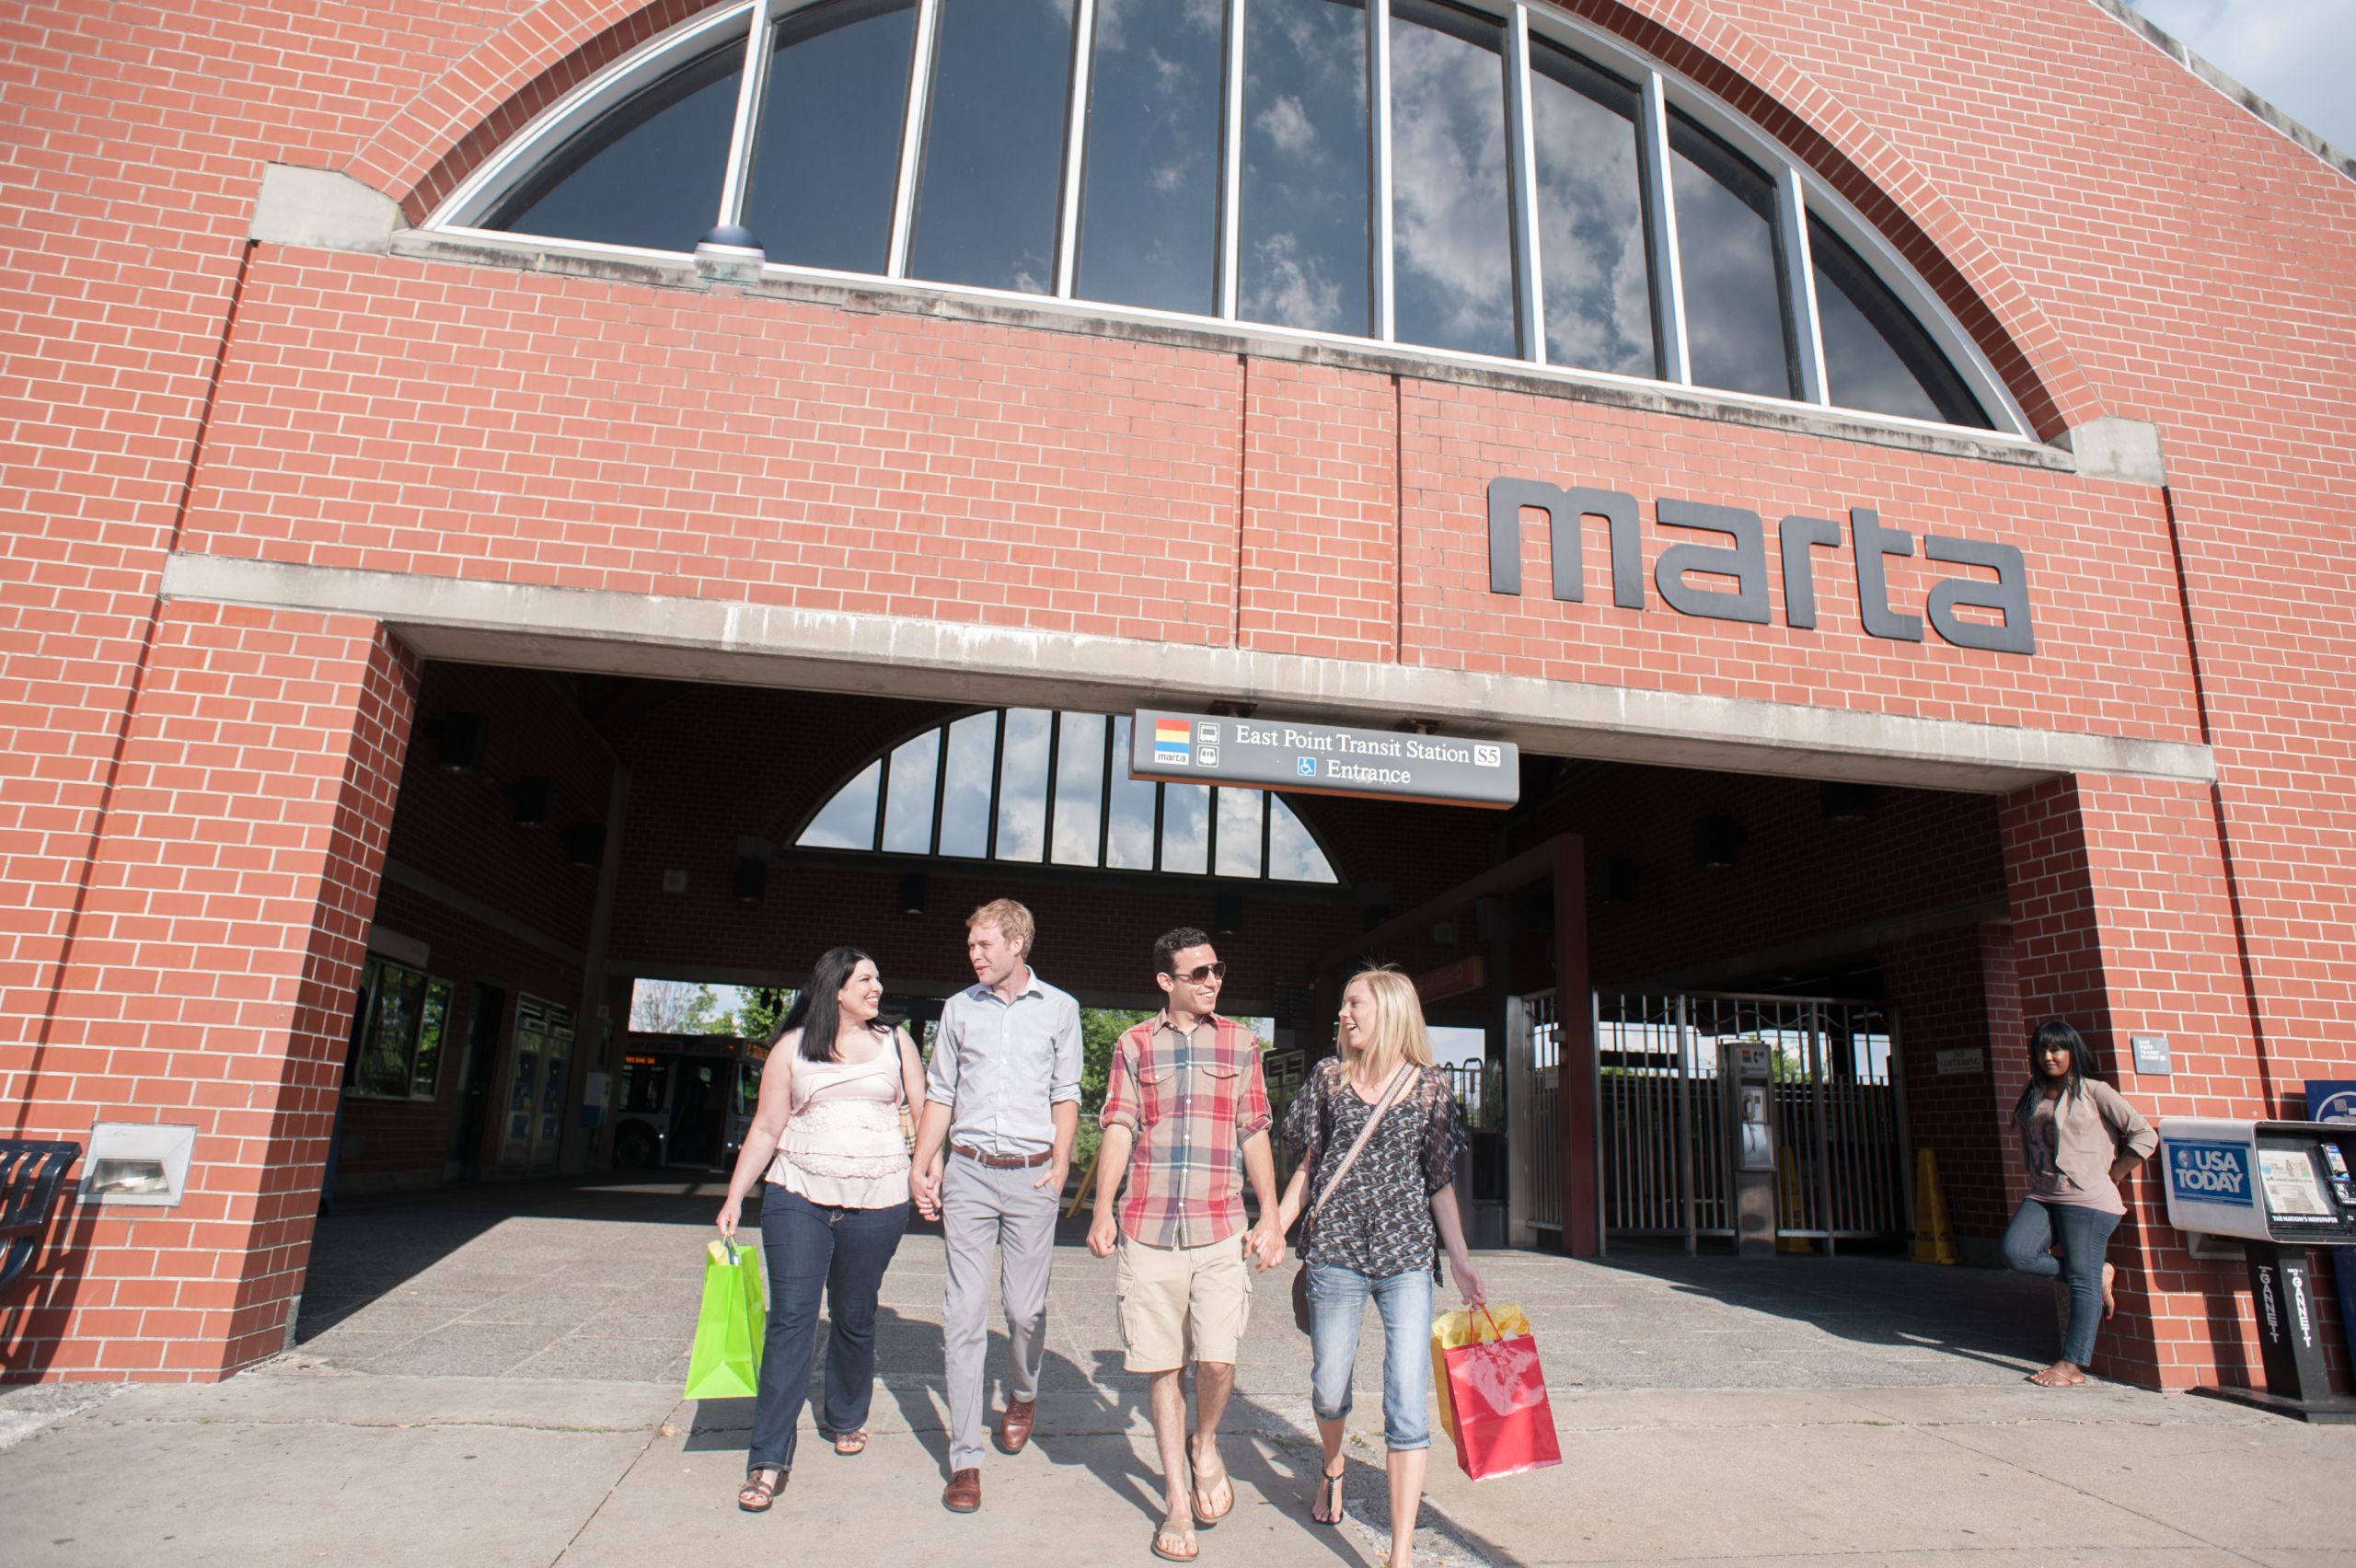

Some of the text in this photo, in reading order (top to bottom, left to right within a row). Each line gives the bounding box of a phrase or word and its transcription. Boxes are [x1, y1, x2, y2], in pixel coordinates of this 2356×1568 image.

[1487, 476, 2036, 655] marta
[1158, 753, 1185, 763] marta
[1235, 724, 1498, 765] East Point Transit Station S5
[1326, 759, 1411, 783] Entrance
[2194, 1150, 2241, 1172] USA
[2175, 1168, 2244, 1193] TODAY
[2259, 1273, 2280, 1343] GANNETT
[2292, 1276, 2312, 1348] GANNETT
